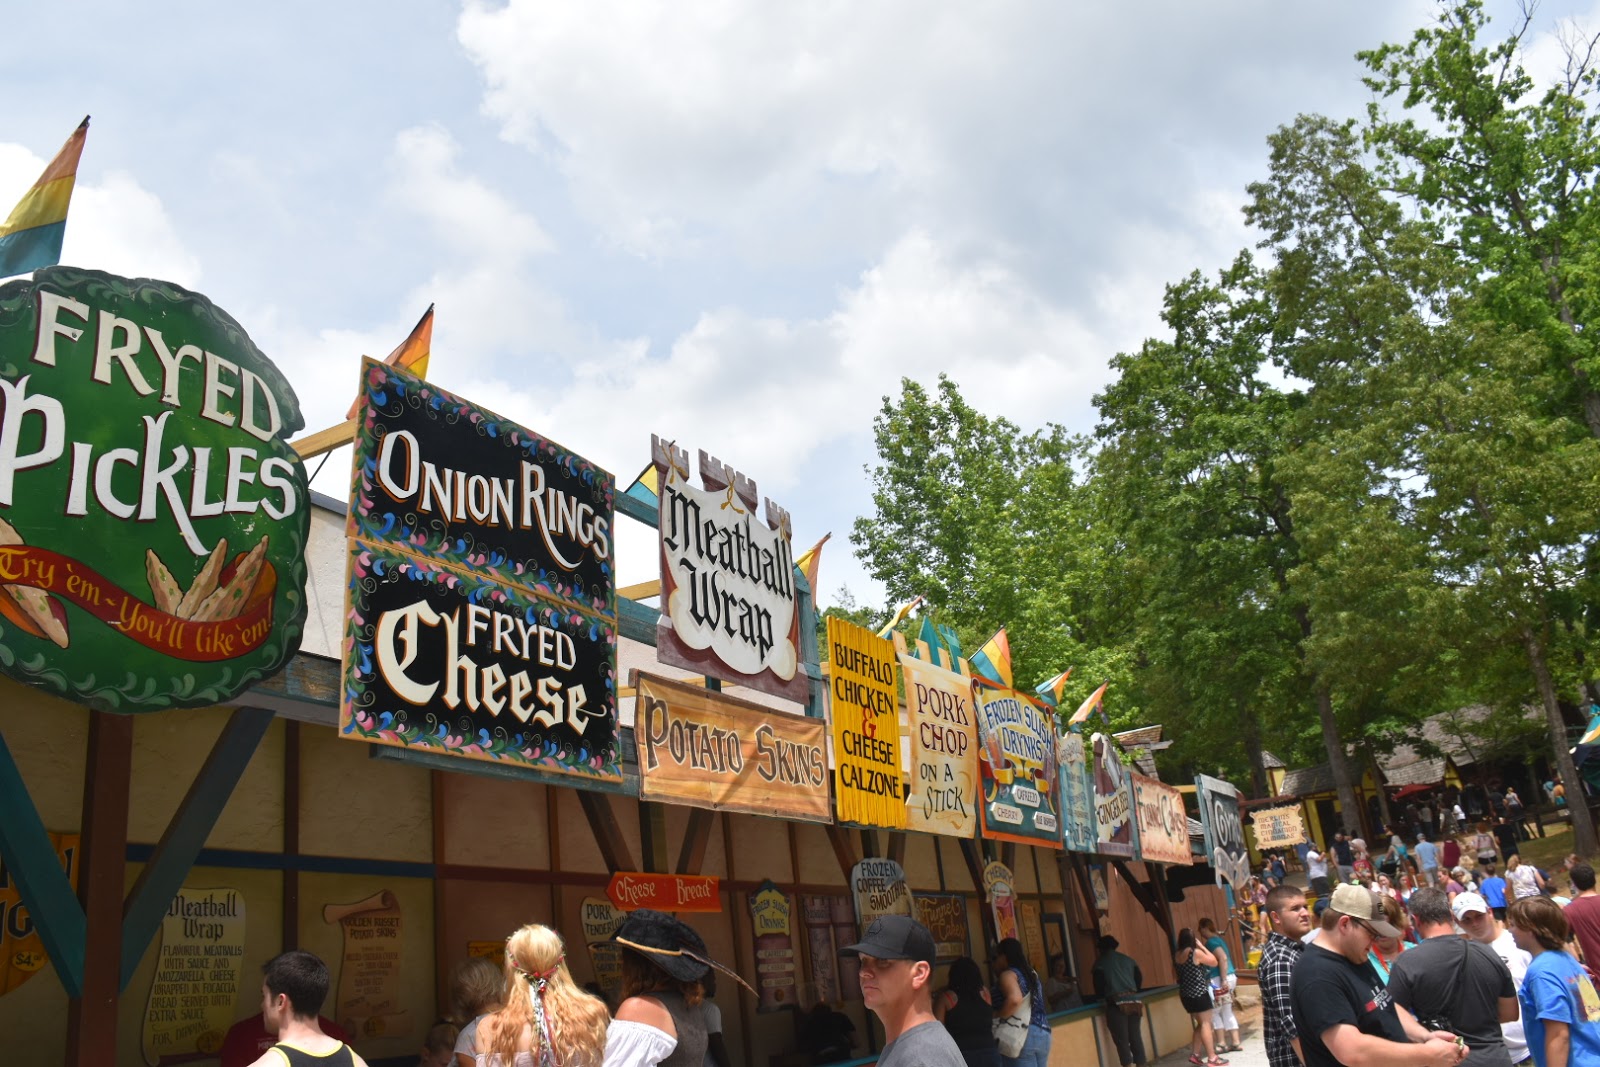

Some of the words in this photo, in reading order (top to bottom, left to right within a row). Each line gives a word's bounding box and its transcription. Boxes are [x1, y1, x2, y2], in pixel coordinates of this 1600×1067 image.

[32, 290, 283, 442] FRYED
[376, 429, 515, 529] ONION
[520, 460, 609, 571] RINGS
[664, 485, 793, 602] Meatball
[0, 548, 54, 588] Try
[196, 626, 235, 656] like
[679, 557, 775, 664] Wrap
[467, 604, 577, 672] FRYED
[376, 600, 607, 736] Cheese
[834, 642, 893, 686] BUFFALO
[835, 677, 894, 717] CHICKEN
[914, 683, 969, 726] PORK
[862, 707, 877, 739] &
[984, 699, 1022, 729] FROZEN
[1024, 705, 1052, 755] SLUSH
[644, 692, 745, 775] POTATO
[755, 723, 826, 788] SKINS
[842, 730, 895, 766] CHEESE
[920, 722, 968, 757] CHOP
[1002, 727, 1043, 762] DRYNKS
[840, 763, 901, 799] CALZONE
[920, 763, 938, 782] ON
[944, 763, 954, 781] A
[923, 786, 968, 820] STICK
[1098, 796, 1121, 825] GINGER
[1260, 821, 1291, 830] MAGICAL
[857, 878, 886, 893] COFFEE
[861, 862, 897, 878] FROZEN
[168, 891, 238, 917] Meatball
[616, 876, 657, 905] Cheese
[676, 877, 714, 905] Bread
[870, 880, 907, 911] SMOOTHIE
[586, 903, 613, 920] PORK
[918, 895, 962, 930] Funnel
[182, 918, 224, 942] Wrap
[350, 929, 374, 940] POTATO
[376, 928, 397, 938] SKINS
[163, 945, 201, 956] FLAVORFUL
[204, 945, 243, 956] MEATBALLS
[164, 957, 184, 969] WITH
[187, 958, 210, 969] SAUCE
[213, 958, 230, 969] AND
[154, 983, 190, 995] WRAPPED
[192, 983, 200, 993] IN
[203, 982, 236, 994] FOCACCIA
[157, 970, 205, 982] MOZZARELLA
[209, 970, 236, 981] CHEESE
[149, 1009, 177, 1022] EXTRA
[181, 1008, 205, 1020] SAUCE
[151, 997, 177, 1009] BREAD
[181, 996, 209, 1008] SERVED
[211, 994, 231, 1006] WITH
[152, 1031, 173, 1046] FOR
[176, 1019, 210, 1042] DIPPING
